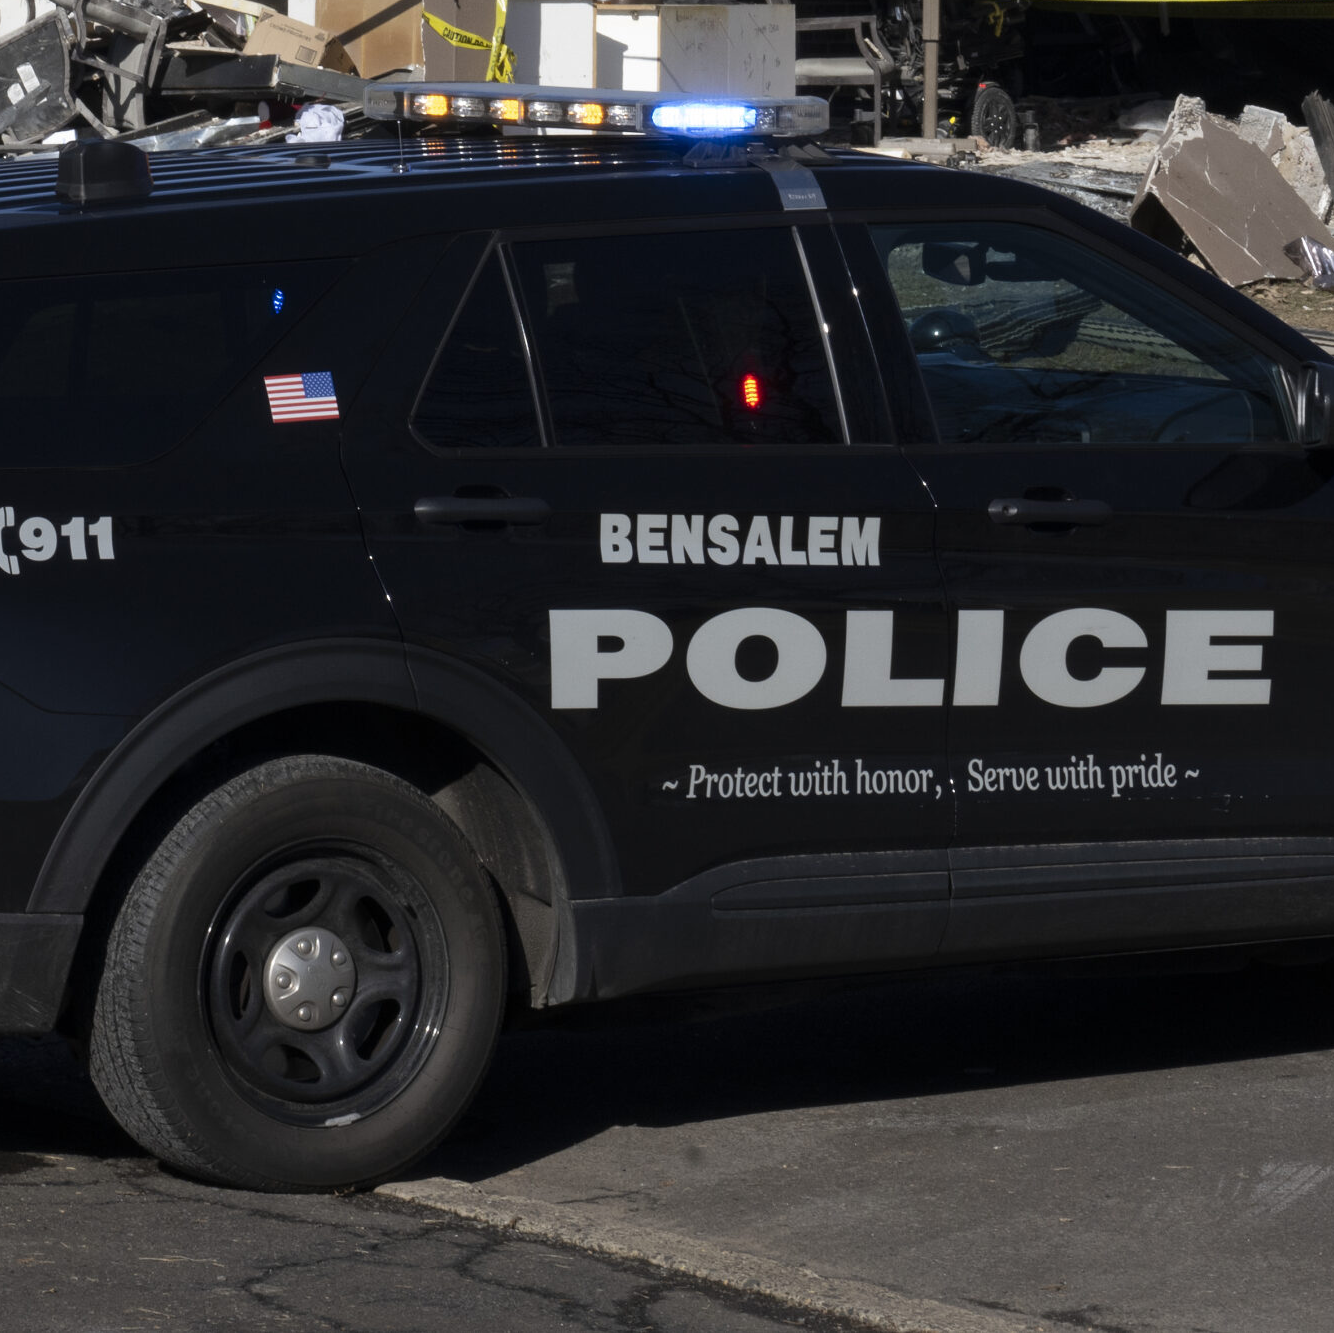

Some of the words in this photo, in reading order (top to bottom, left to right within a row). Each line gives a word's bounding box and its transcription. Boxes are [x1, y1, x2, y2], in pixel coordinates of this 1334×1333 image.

[443, 27, 471, 45] CAUTION
[19, 516, 115, 561] 911
[599, 514, 881, 566] BENSALEM
[549, 607, 1275, 710] POLICE
[686, 764, 783, 799] Protect
[788, 759, 850, 797] with
[855, 759, 943, 800] honor,
[968, 759, 1040, 792] Serve
[1045, 754, 1105, 790] with
[1109, 752, 1178, 797] pride
